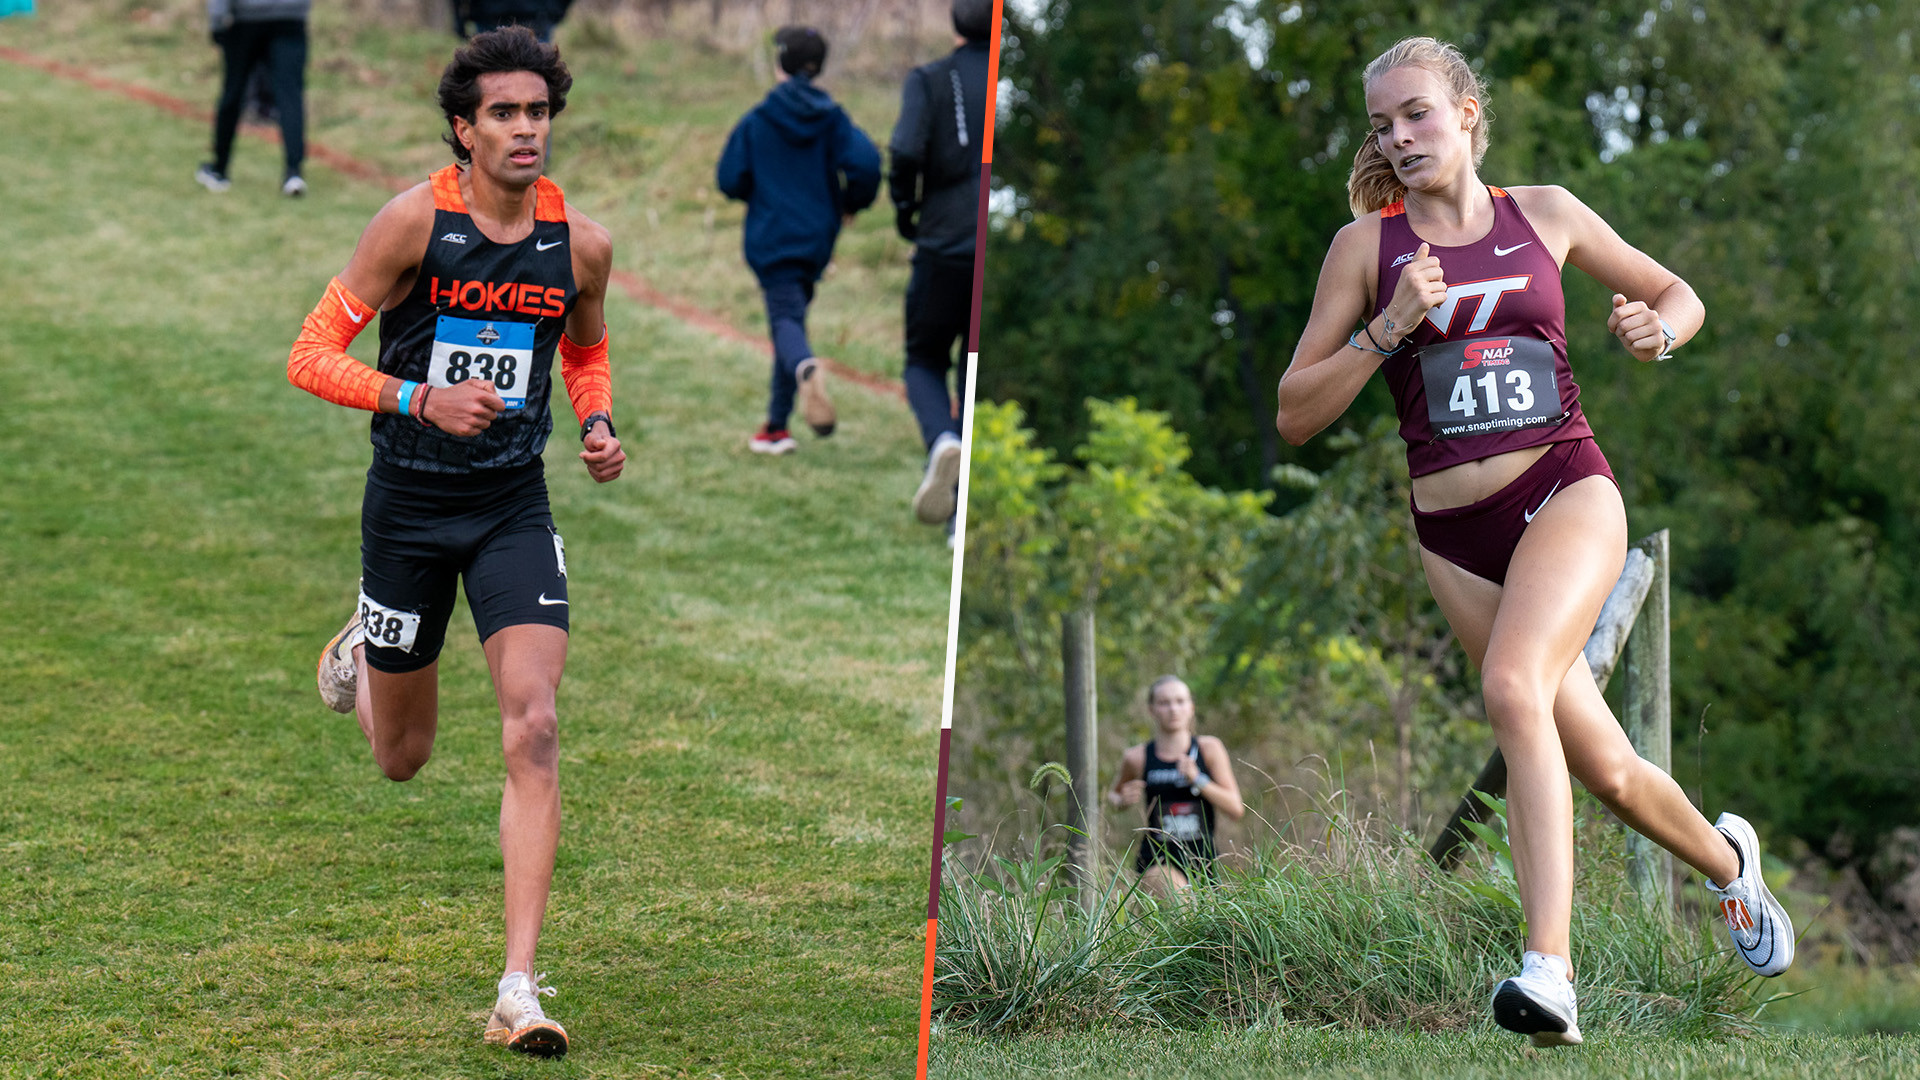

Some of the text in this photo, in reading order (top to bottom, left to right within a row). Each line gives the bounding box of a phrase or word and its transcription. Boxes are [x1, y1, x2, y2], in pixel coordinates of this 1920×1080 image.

[441, 233, 467, 244] ACC
[1391, 252, 1415, 267] ACC
[430, 276, 565, 317] HOKIES
[1424, 274, 1533, 339] VT
[446, 351, 517, 390] 838
[1460, 339, 1514, 369] SNAP
[1481, 358, 1510, 366] TIMING
[1449, 369, 1535, 417] 413
[1442, 414, 1547, 435] www.snaptiming.com
[361, 601, 403, 645] 838
